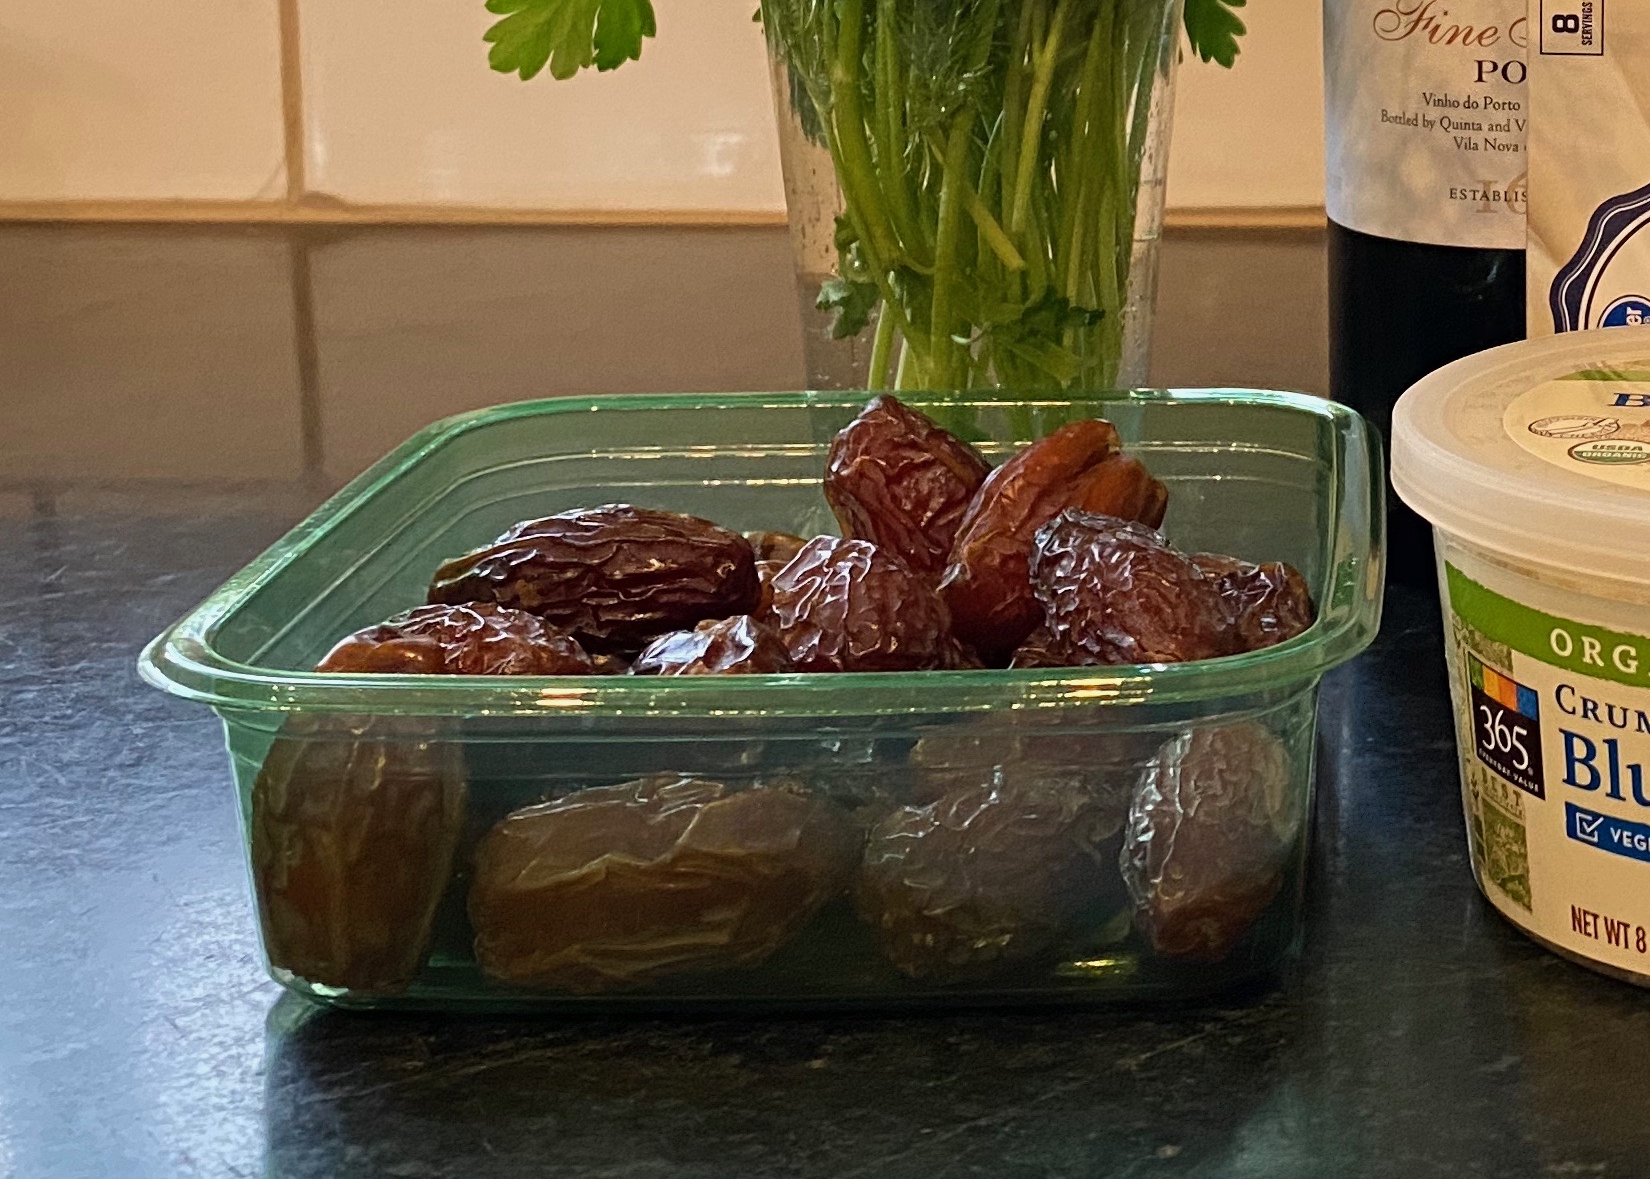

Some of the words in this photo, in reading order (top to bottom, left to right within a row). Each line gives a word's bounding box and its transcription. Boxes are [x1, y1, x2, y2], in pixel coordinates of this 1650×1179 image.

[1552, 13, 1580, 34] 8
[1582, 1, 1593, 46] SERVINGS
[1473, 59, 1527, 84] PO
[1422, 92, 1460, 108] Vinho
[1463, 94, 1479, 110] do
[1483, 96, 1521, 111] Porto
[1381, 109, 1418, 127] Bottled
[1422, 113, 1436, 131] by
[1440, 116, 1482, 133] Quinta
[1488, 118, 1511, 132] and
[1454, 136, 1479, 151] Vila
[1484, 138, 1519, 152] Nova
[1449, 188, 1527, 202] ESTABLIS
[1480, 705, 1529, 770] 365
[1570, 904, 1599, 937] NET
[1603, 913, 1631, 949] WT
[1635, 927, 1648, 955] 8
